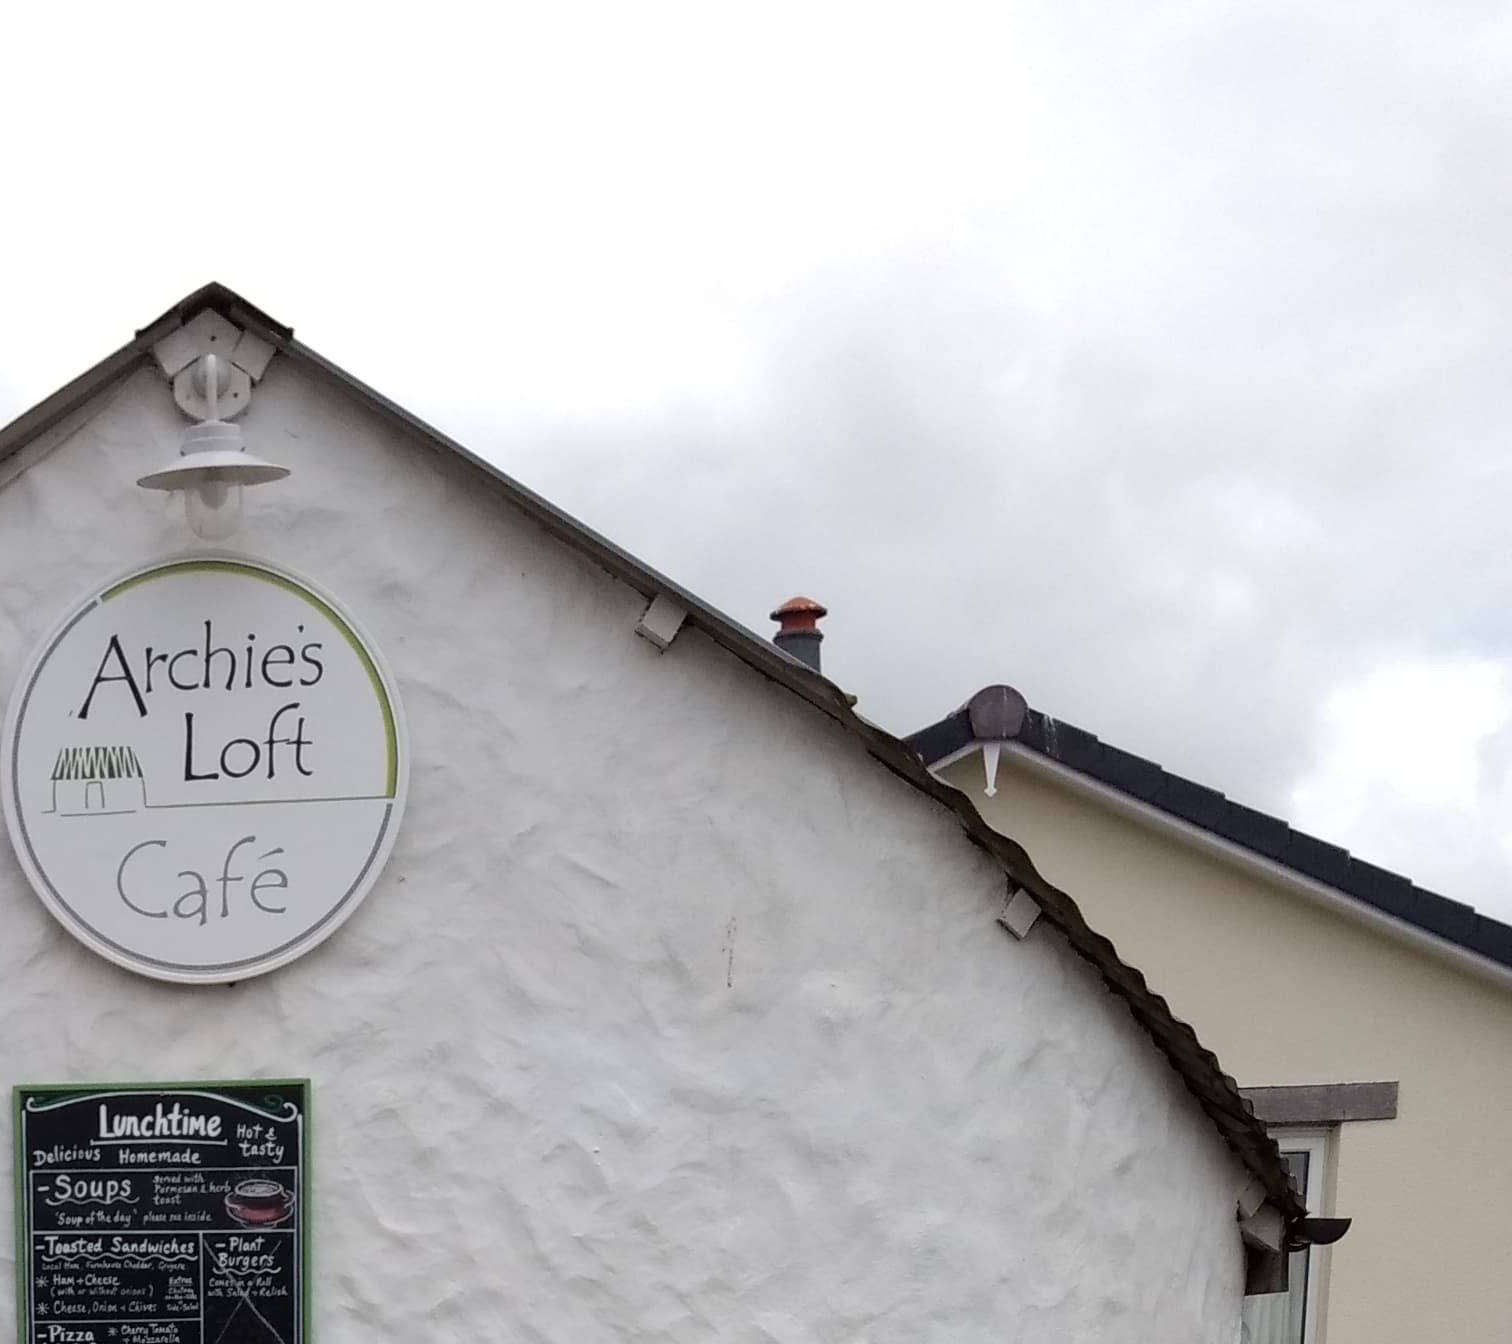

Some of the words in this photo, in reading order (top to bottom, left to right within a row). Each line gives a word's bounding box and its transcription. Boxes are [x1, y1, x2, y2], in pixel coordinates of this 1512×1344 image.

[78, 620, 324, 720] Archie's
[184, 702, 313, 781] Loft
[117, 835, 288, 926] Café
[99, 1102, 223, 1138] Lunchtime
[237, 1123, 263, 1140] Hot
[33, 1145, 101, 1166] Delicious
[119, 1148, 201, 1165] Homemade
[238, 1140, 285, 1164] tasty
[44, 1236, 103, 1255] Toasted
[111, 1236, 195, 1254] Sandwiches
[229, 1236, 265, 1252] Plant
[217, 1253, 275, 1271] Burgers
[85, 1273, 121, 1286] Cheese
[48, 1325, 94, 1343] Pizza
